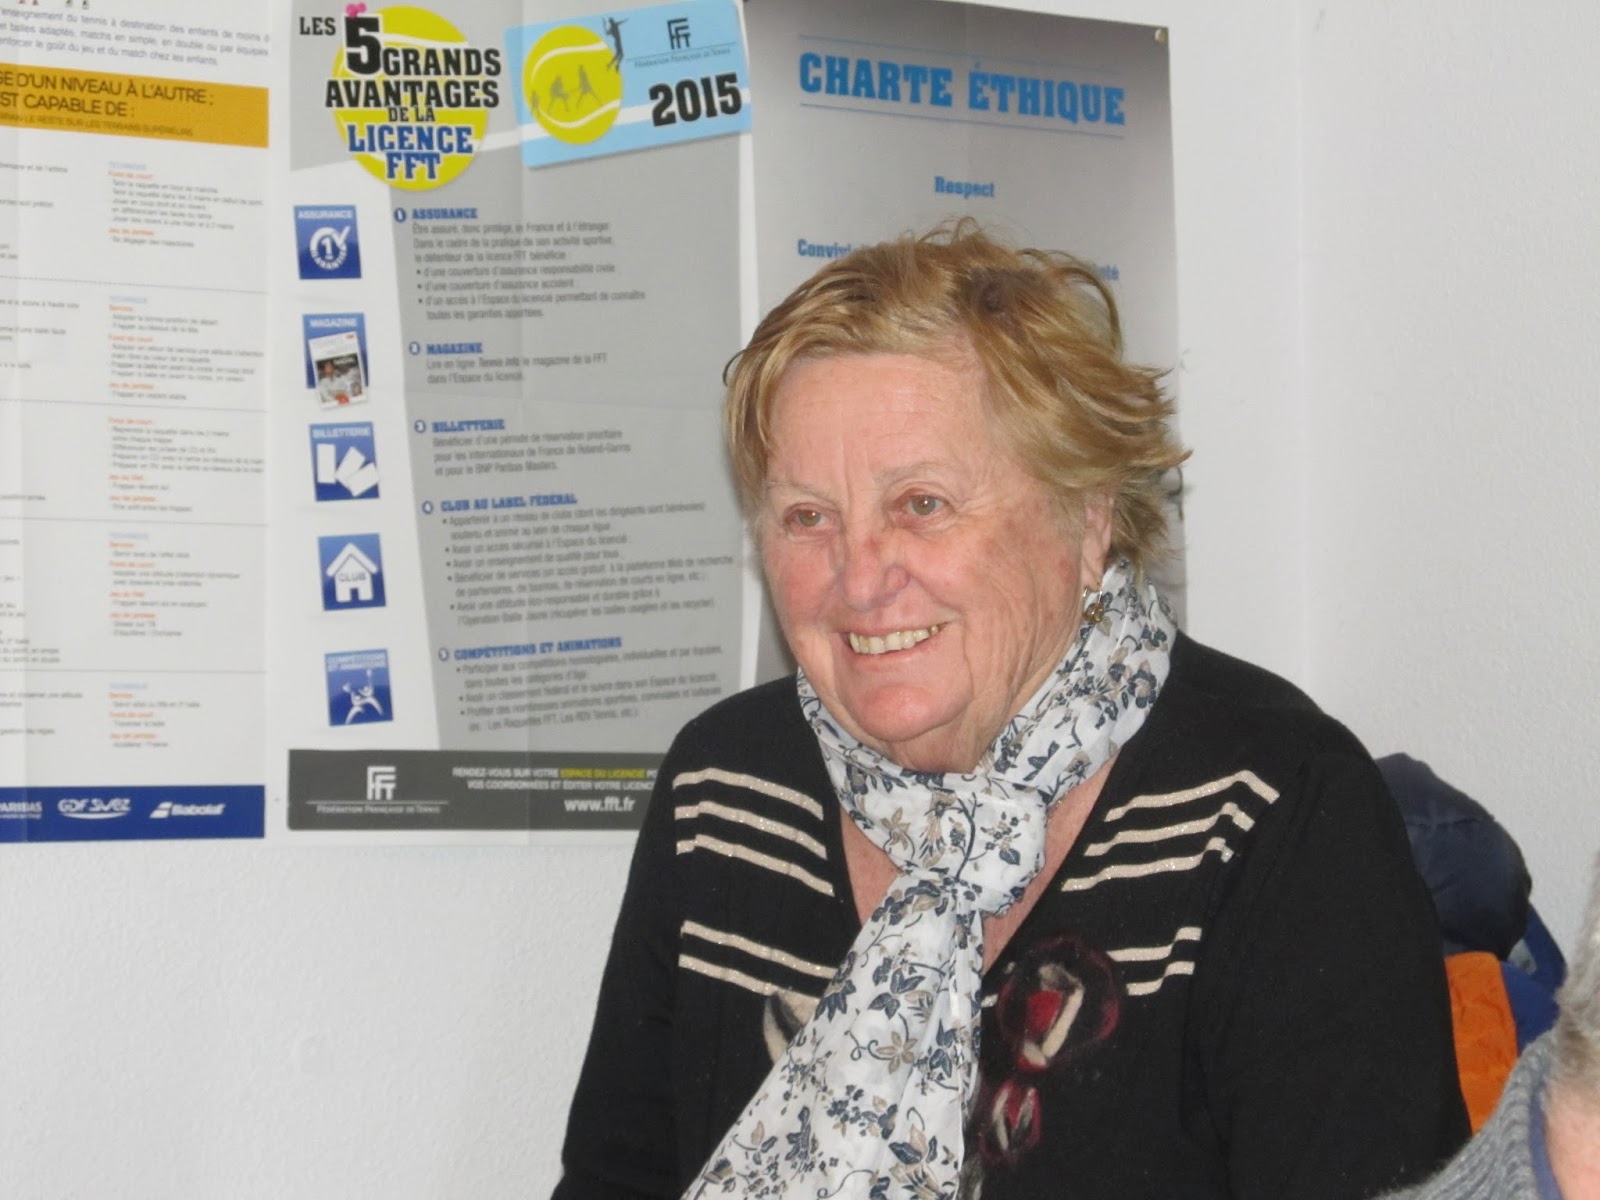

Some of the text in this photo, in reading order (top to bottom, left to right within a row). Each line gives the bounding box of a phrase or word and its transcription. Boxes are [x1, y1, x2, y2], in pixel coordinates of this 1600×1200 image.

[66, 13, 78, 23] du
[80, 15, 108, 26] tennis
[169, 24, 184, 34] des
[188, 25, 219, 38] enfants
[222, 29, 233, 39] de
[114, 34, 126, 42] en
[162, 38, 172, 46] en
[176, 37, 204, 49] double
[206, 42, 218, 50] ou
[299, 16, 502, 76] LES 5 GRANDS
[36, 39, 44, 48] le
[68, 43, 80, 52] du
[96, 45, 106, 54] et
[108, 46, 120, 56] du
[121, 47, 148, 59] match
[172, 52, 184, 62] les
[16, 72, 57, 90] D'UN
[60, 76, 122, 96] NIVEAU
[126, 79, 139, 97] À
[142, 83, 207, 104] L'AUTRE
[325, 79, 500, 108] AVANTAGES
[800, 52, 1126, 126] CHARTE ÉTHIQUE
[24, 93, 101, 115] CAPABLE
[105, 101, 127, 117] DE
[650, 72, 743, 127] 2015
[388, 107, 436, 122] DE LA
[347, 124, 473, 153] LICENCE
[386, 152, 441, 179] FFT
[934, 175, 995, 199] Respect
[412, 208, 479, 219] ASSURANCE
[309, 317, 358, 328] MAGAZINE
[427, 342, 483, 354] MAGAZINE
[312, 426, 371, 439] BILLETTERIE
[432, 419, 505, 432] BILLETTERIE
[440, 499, 470, 512] CLUB
[473, 498, 489, 510] AU
[491, 496, 526, 509] LABEL
[338, 572, 366, 582] CLUB
[540, 642, 554, 654] ET
[557, 637, 622, 651] ANIMATIONS
[513, 767, 531, 777] SUR
[532, 767, 559, 778] VOTRE
[467, 779, 484, 790] VOS
[593, 780, 620, 790] VOTRE
[57, 798, 88, 812] GDF
[171, 802, 226, 816] Babolat
[564, 796, 637, 812] www.fft.fr
